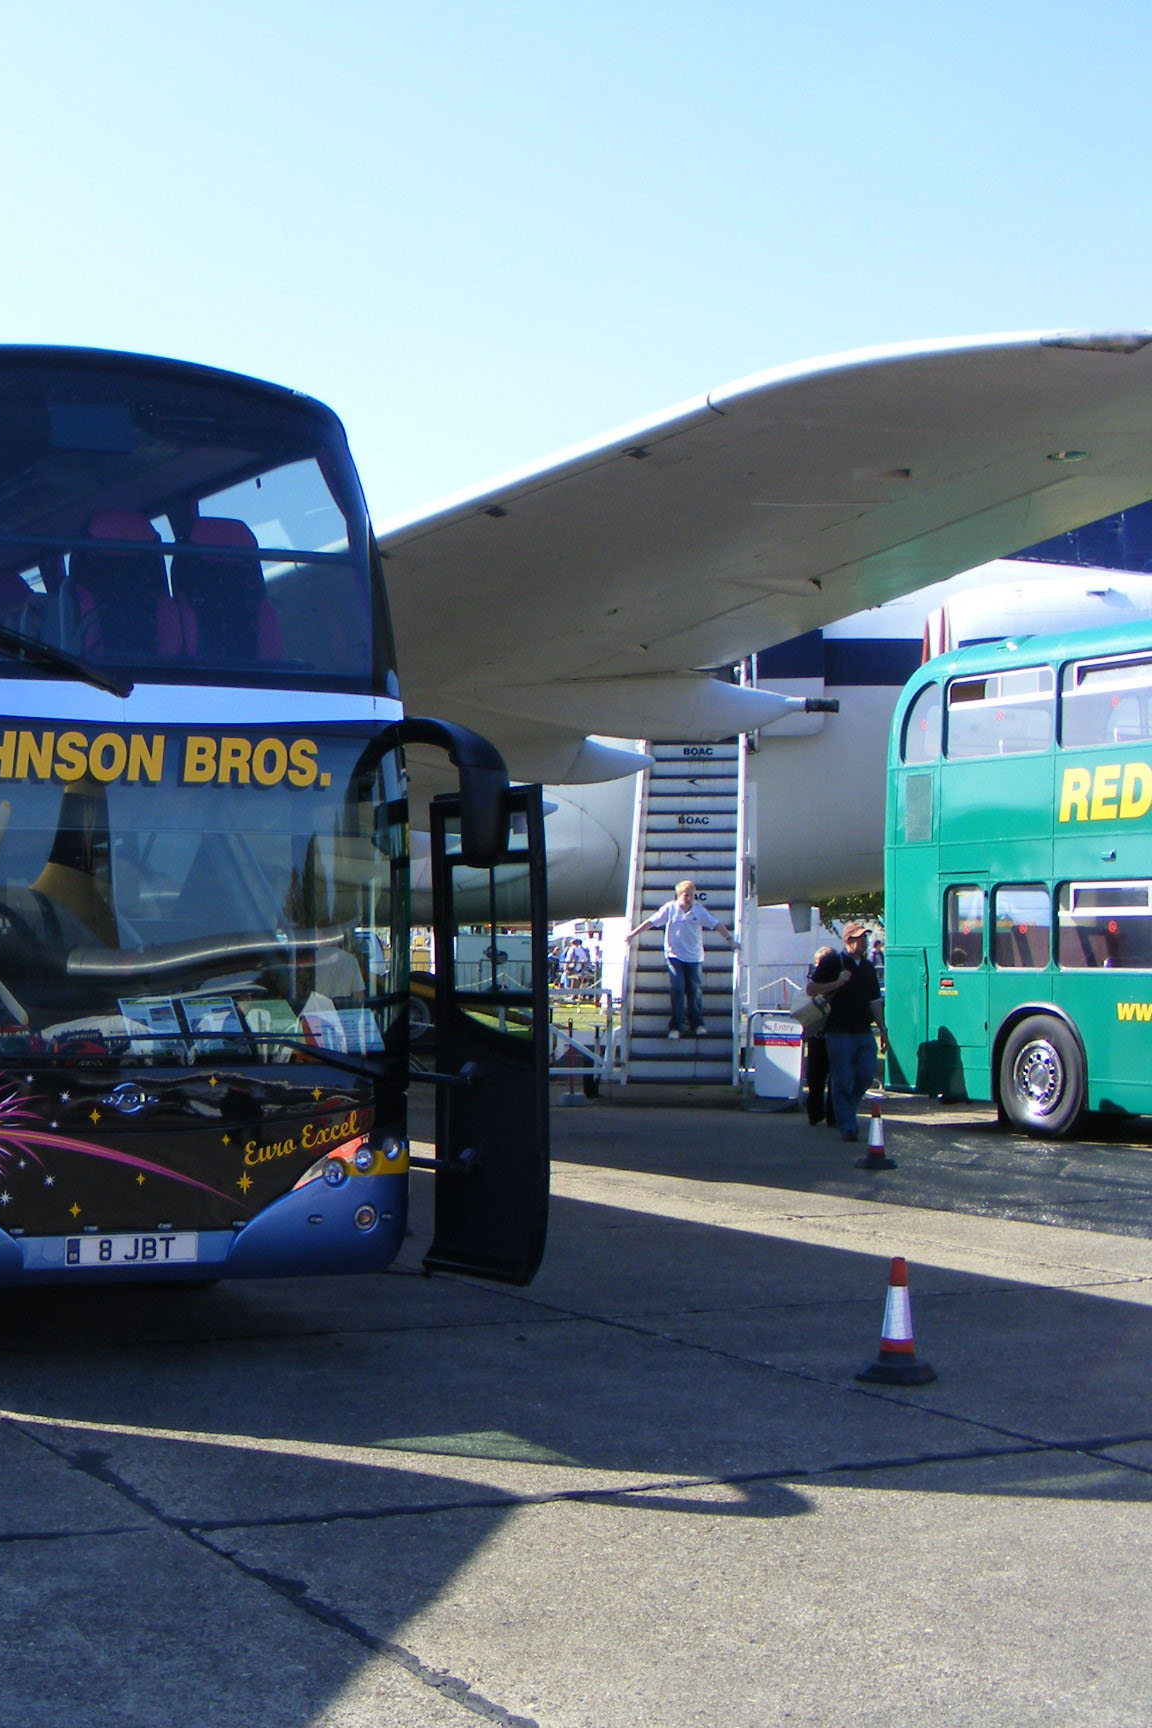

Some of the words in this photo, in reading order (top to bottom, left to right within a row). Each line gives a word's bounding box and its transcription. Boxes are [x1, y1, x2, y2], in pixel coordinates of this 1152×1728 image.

[182, 735, 332, 788] BROS.
[682, 747, 714, 756] BOAC
[1058, 762, 1152, 823] RED
[678, 816, 710, 825] BOAC
[774, 1024, 794, 1032] Entry
[244, 1139, 298, 1167] Euro
[301, 1110, 360, 1149] Excel
[99, 1239, 112, 1261] 8
[124, 1237, 176, 1260] JBT
